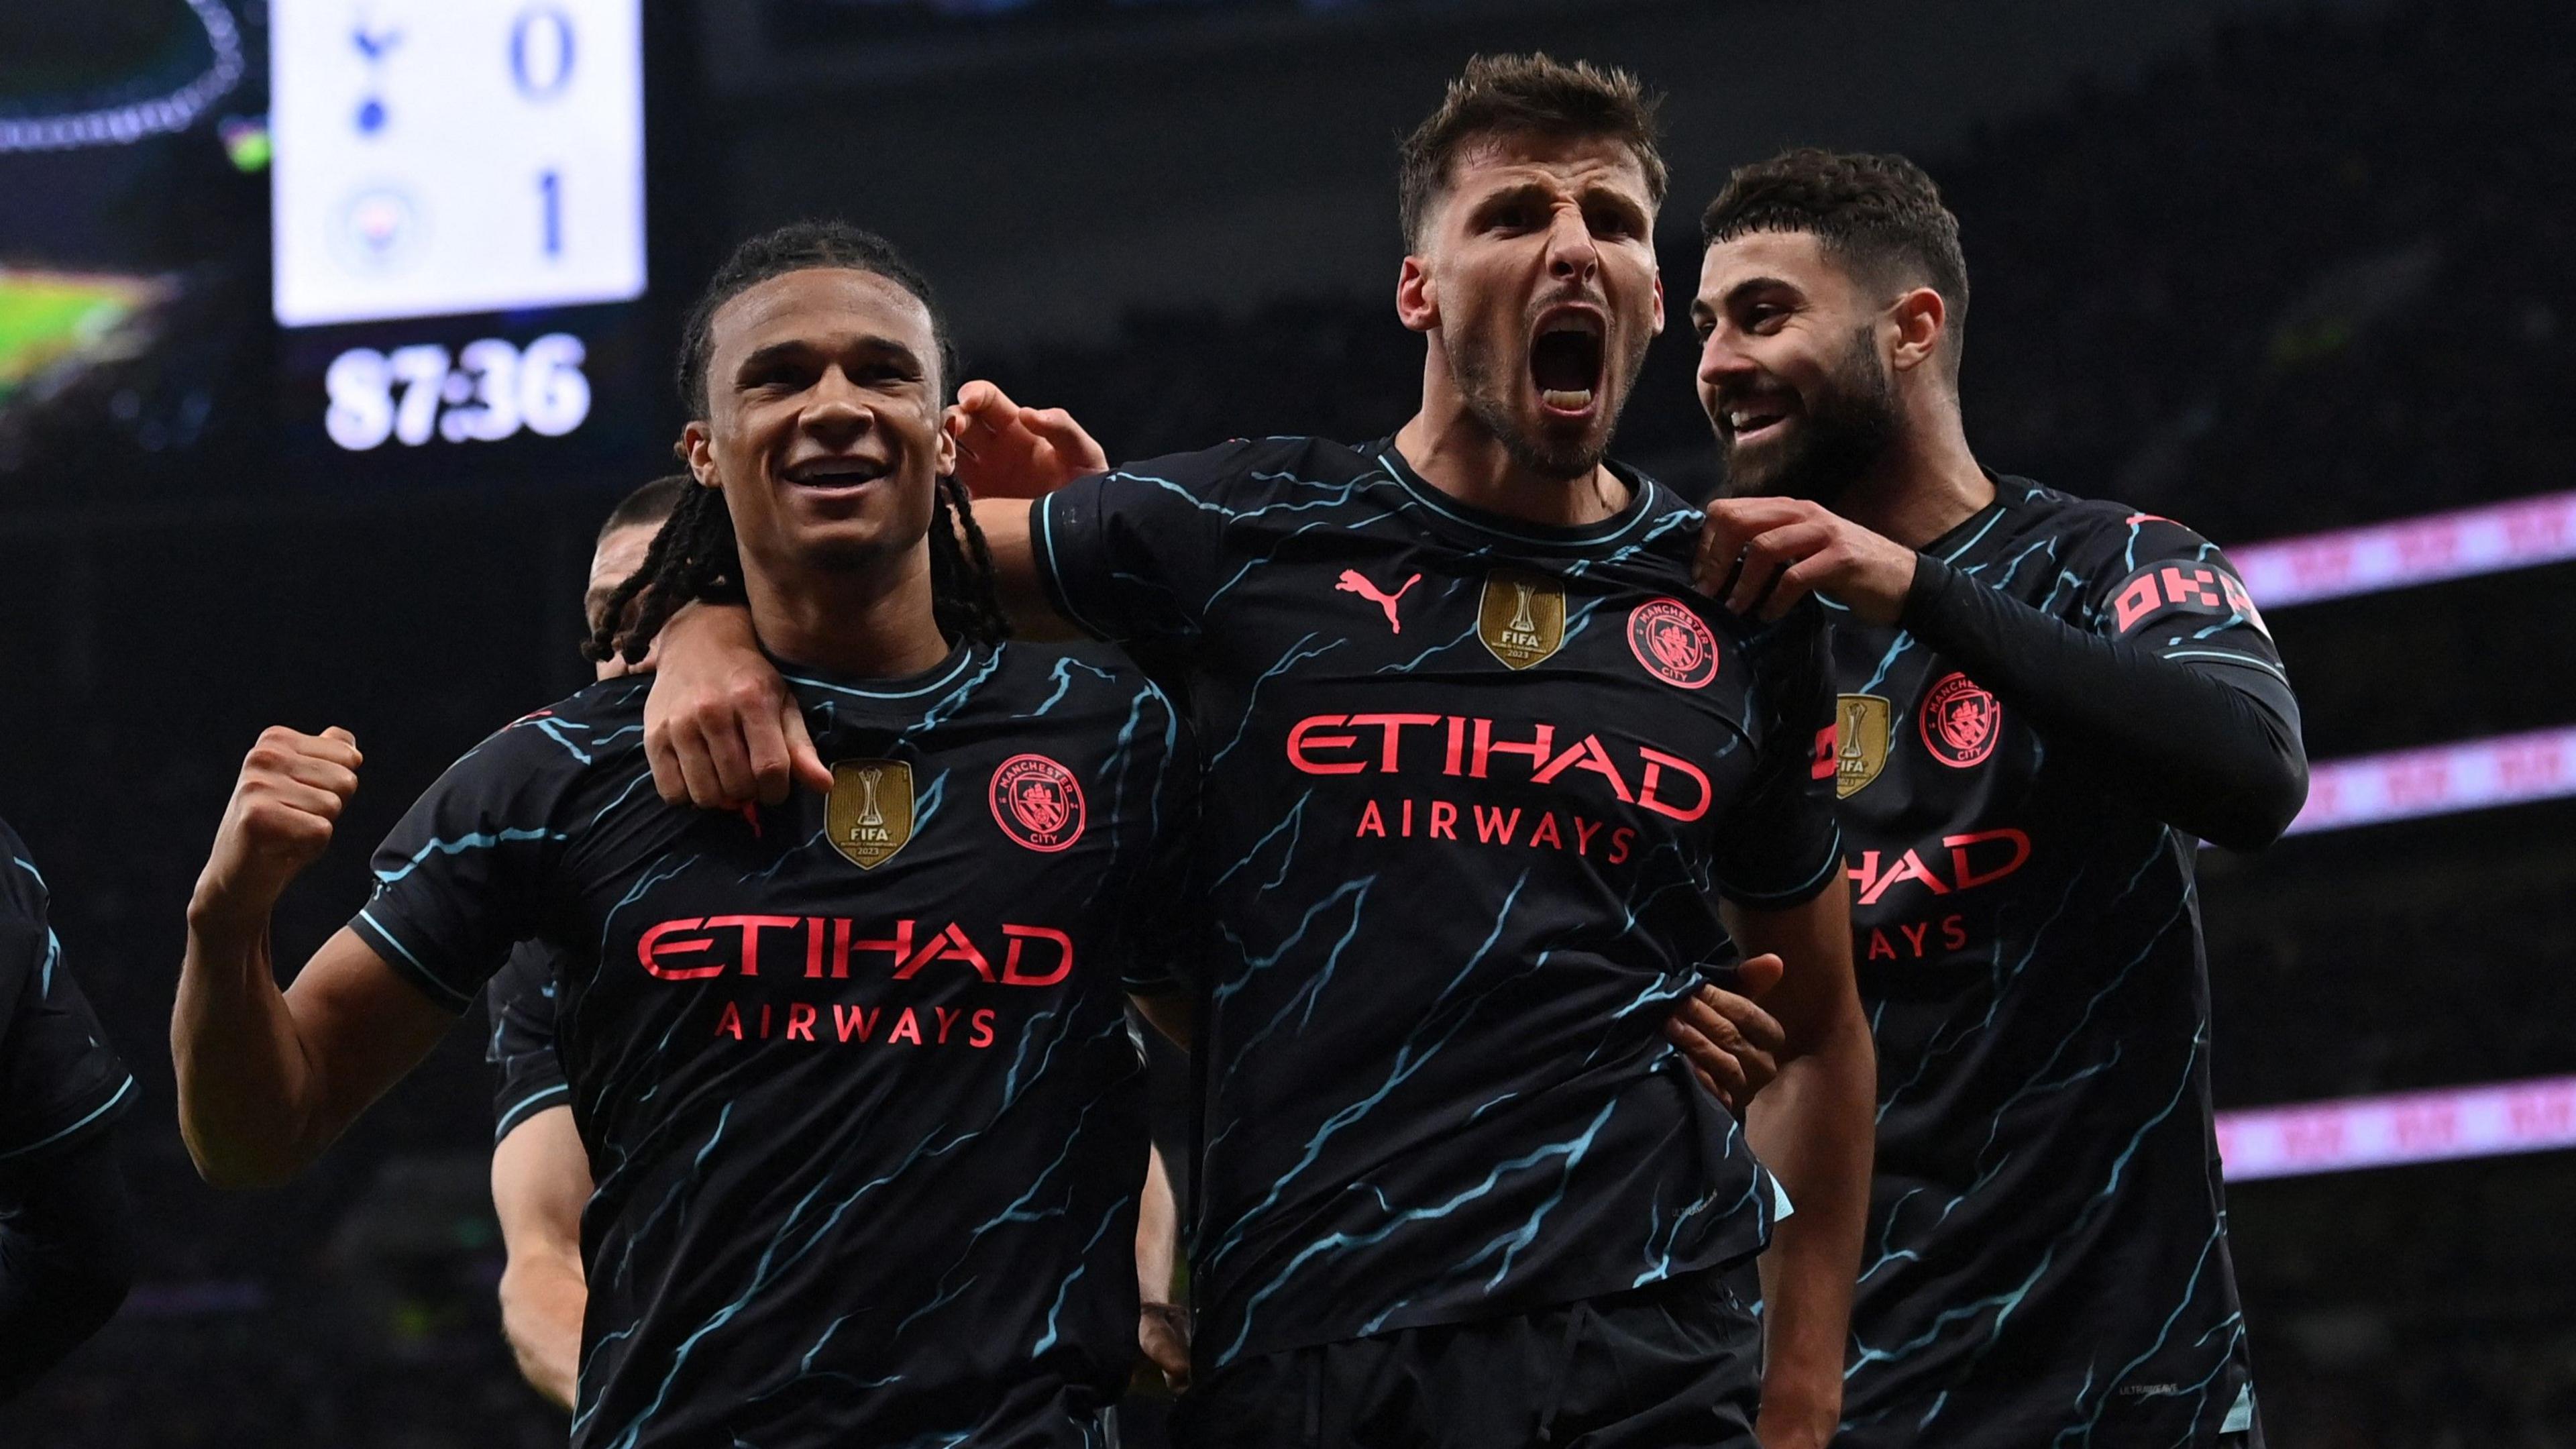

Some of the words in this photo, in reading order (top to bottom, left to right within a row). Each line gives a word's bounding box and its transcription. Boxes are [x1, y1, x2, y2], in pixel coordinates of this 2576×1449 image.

[508, 6, 576, 101] 0
[537, 167, 564, 261] 1
[325, 333, 590, 451] 87:36
[1501, 631, 1539, 647] FIFA
[1640, 605, 1709, 644] MANCHESTER
[1508, 650, 1529, 659] 2023
[1662, 667, 1688, 682] CITY
[1930, 679, 1980, 713] MANCHE
[1287, 713, 1712, 822] ETIHAD
[1957, 747, 1982, 760] CITY
[1000, 761, 1073, 794] MANCHESTER
[850, 828, 889, 841] FIFA
[1030, 833, 1058, 844] CITY
[1356, 799, 1635, 865] AIRWAYS
[857, 847, 879, 855] 2023
[1847, 828, 2031, 905] HAD
[637, 914, 1073, 986] ETIHAD
[715, 1000, 996, 1049] AIRWAYS
